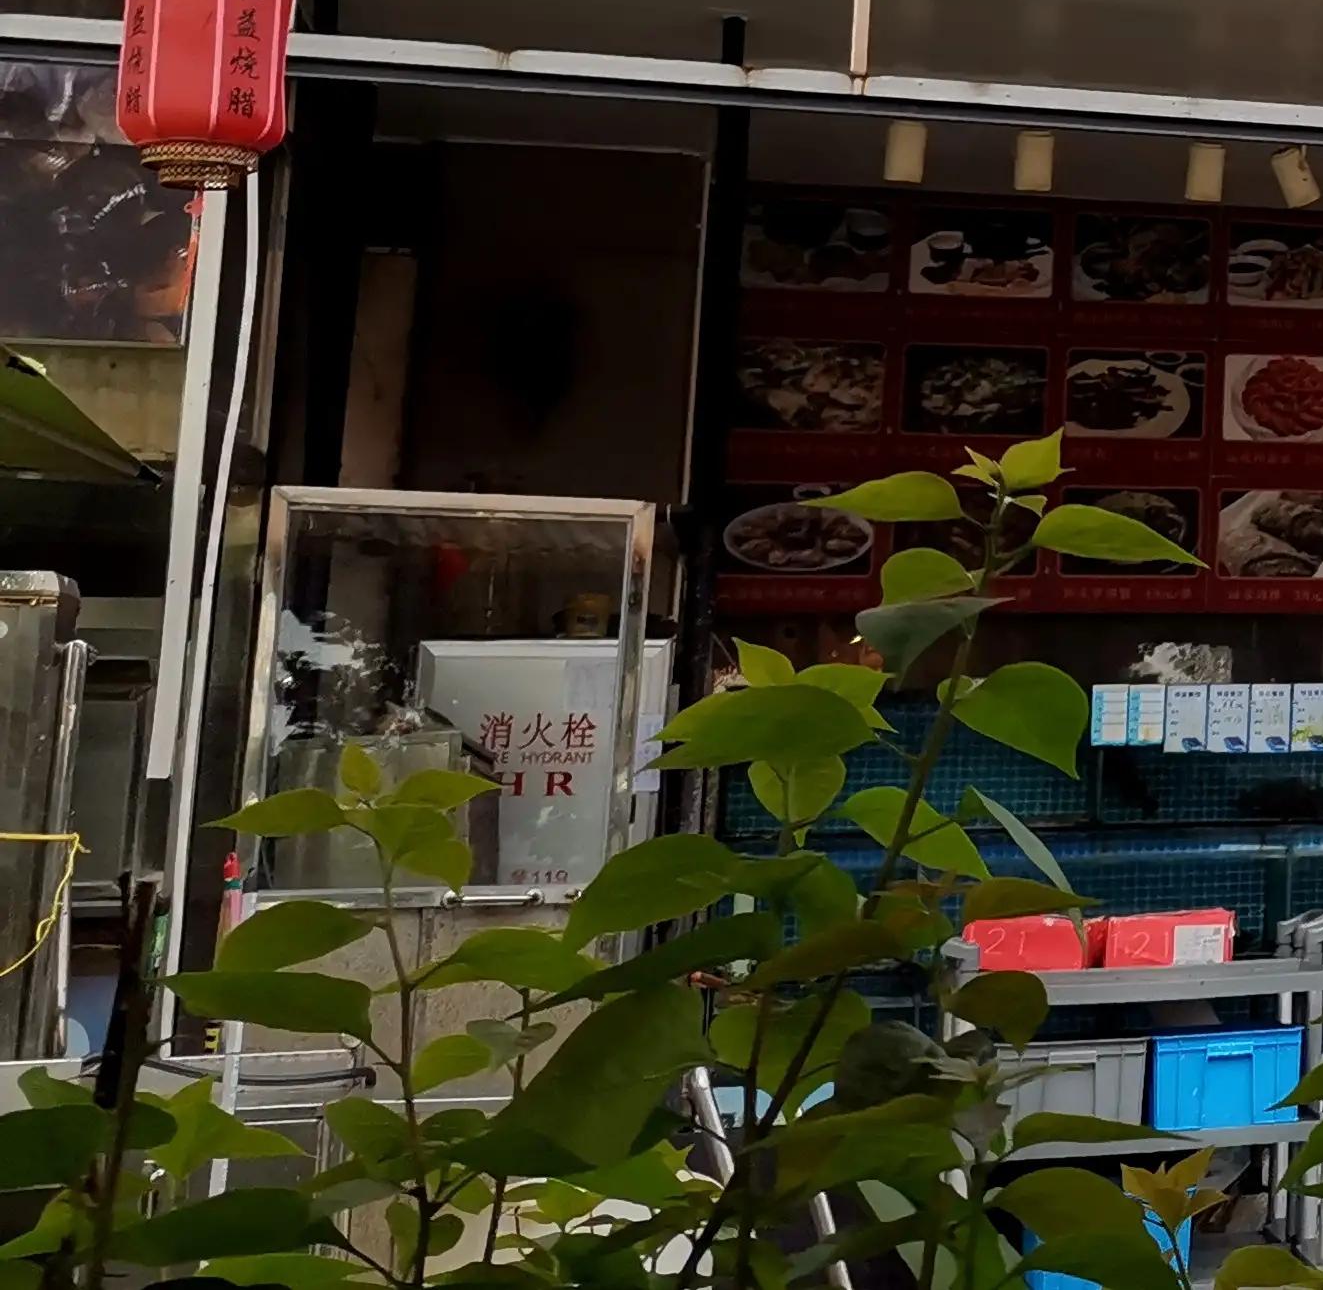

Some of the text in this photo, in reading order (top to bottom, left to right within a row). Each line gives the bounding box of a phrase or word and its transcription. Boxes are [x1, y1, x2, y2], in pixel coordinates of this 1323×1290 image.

[479, 711, 597, 749] 消火栓
[521, 751, 594, 765] HYDRANT
